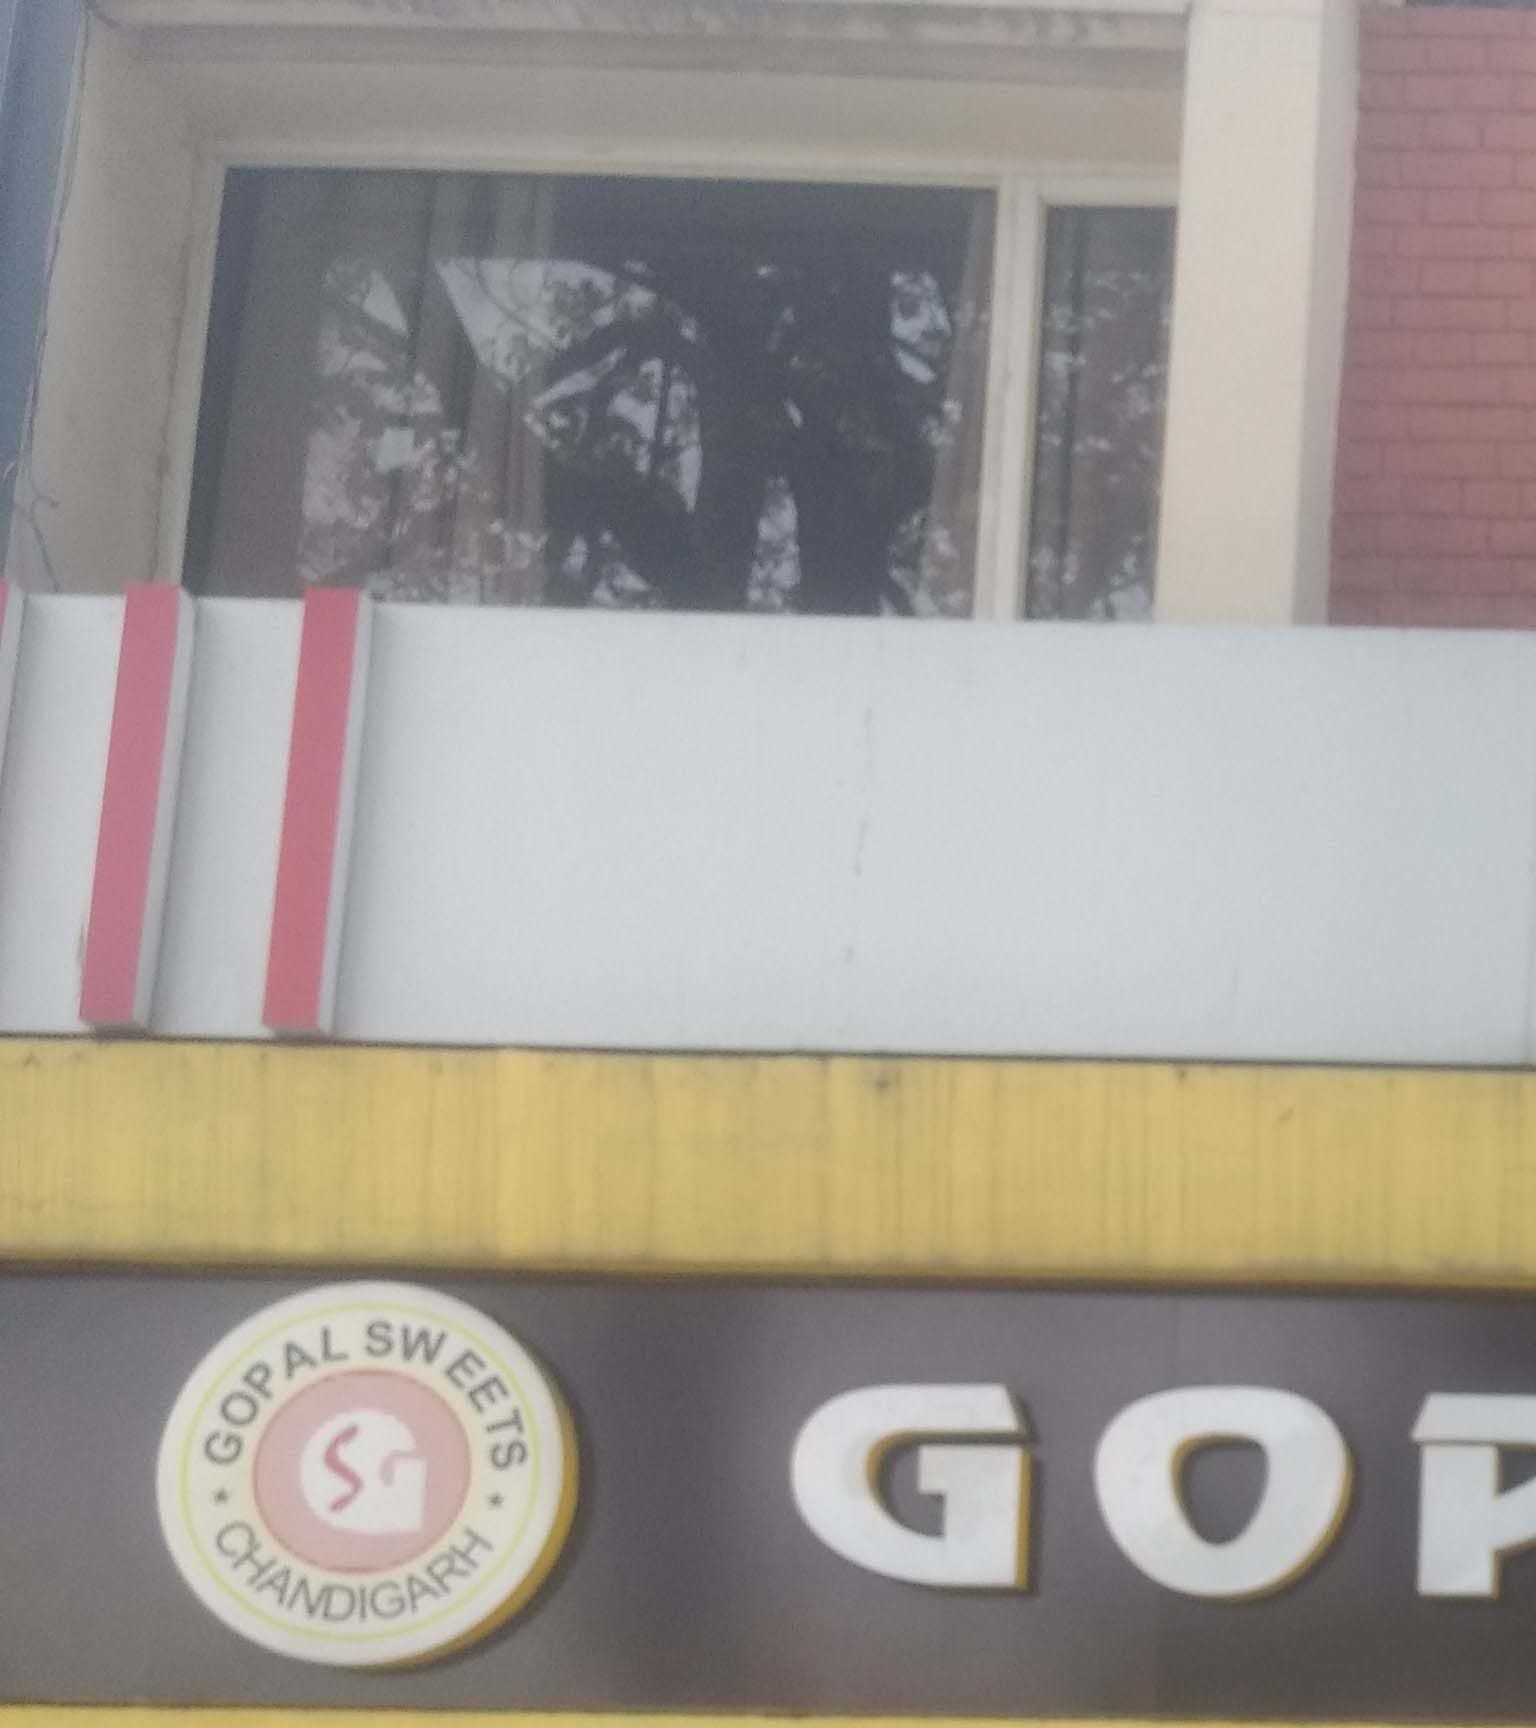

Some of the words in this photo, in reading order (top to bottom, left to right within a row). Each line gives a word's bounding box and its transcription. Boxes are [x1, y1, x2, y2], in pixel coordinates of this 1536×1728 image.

[204, 1325, 350, 1468] GOPAL
[364, 1320, 529, 1470] SWEETS
[214, 1518, 494, 1624] CHANDIGARH
